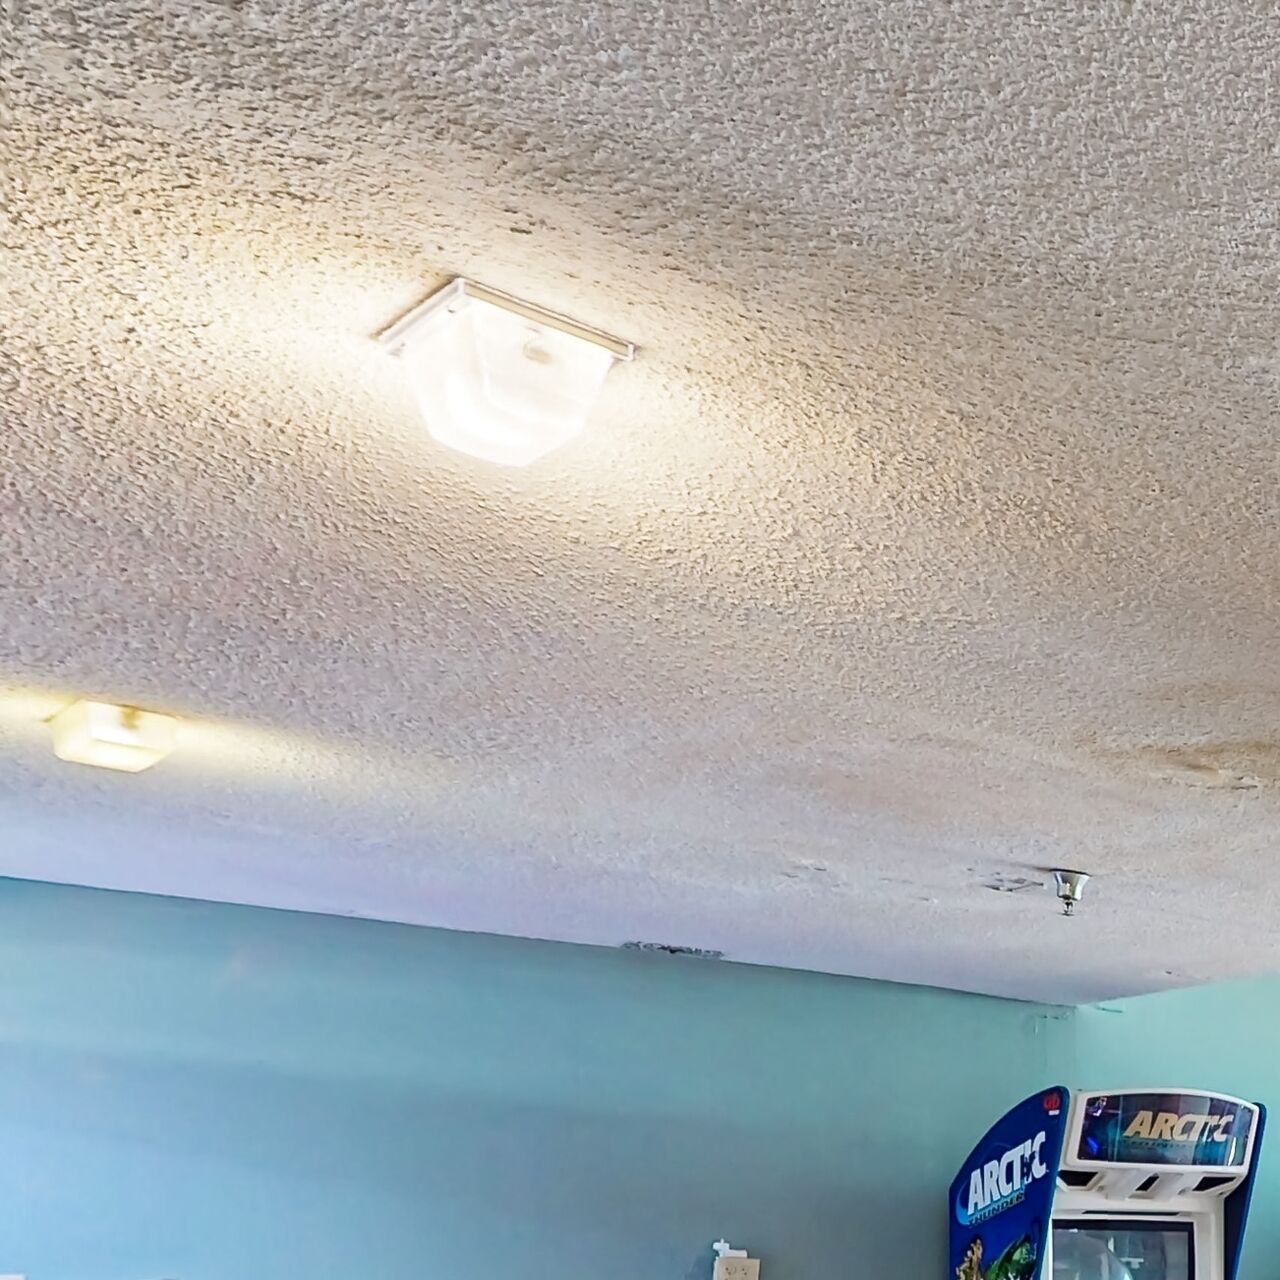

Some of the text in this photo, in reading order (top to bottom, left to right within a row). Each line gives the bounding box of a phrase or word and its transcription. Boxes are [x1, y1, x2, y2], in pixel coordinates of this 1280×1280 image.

[1122, 1110, 1235, 1143] ARCTIC
[966, 1131, 1048, 1216] ARCTIC
[967, 1193, 1026, 1228] THUNDER
